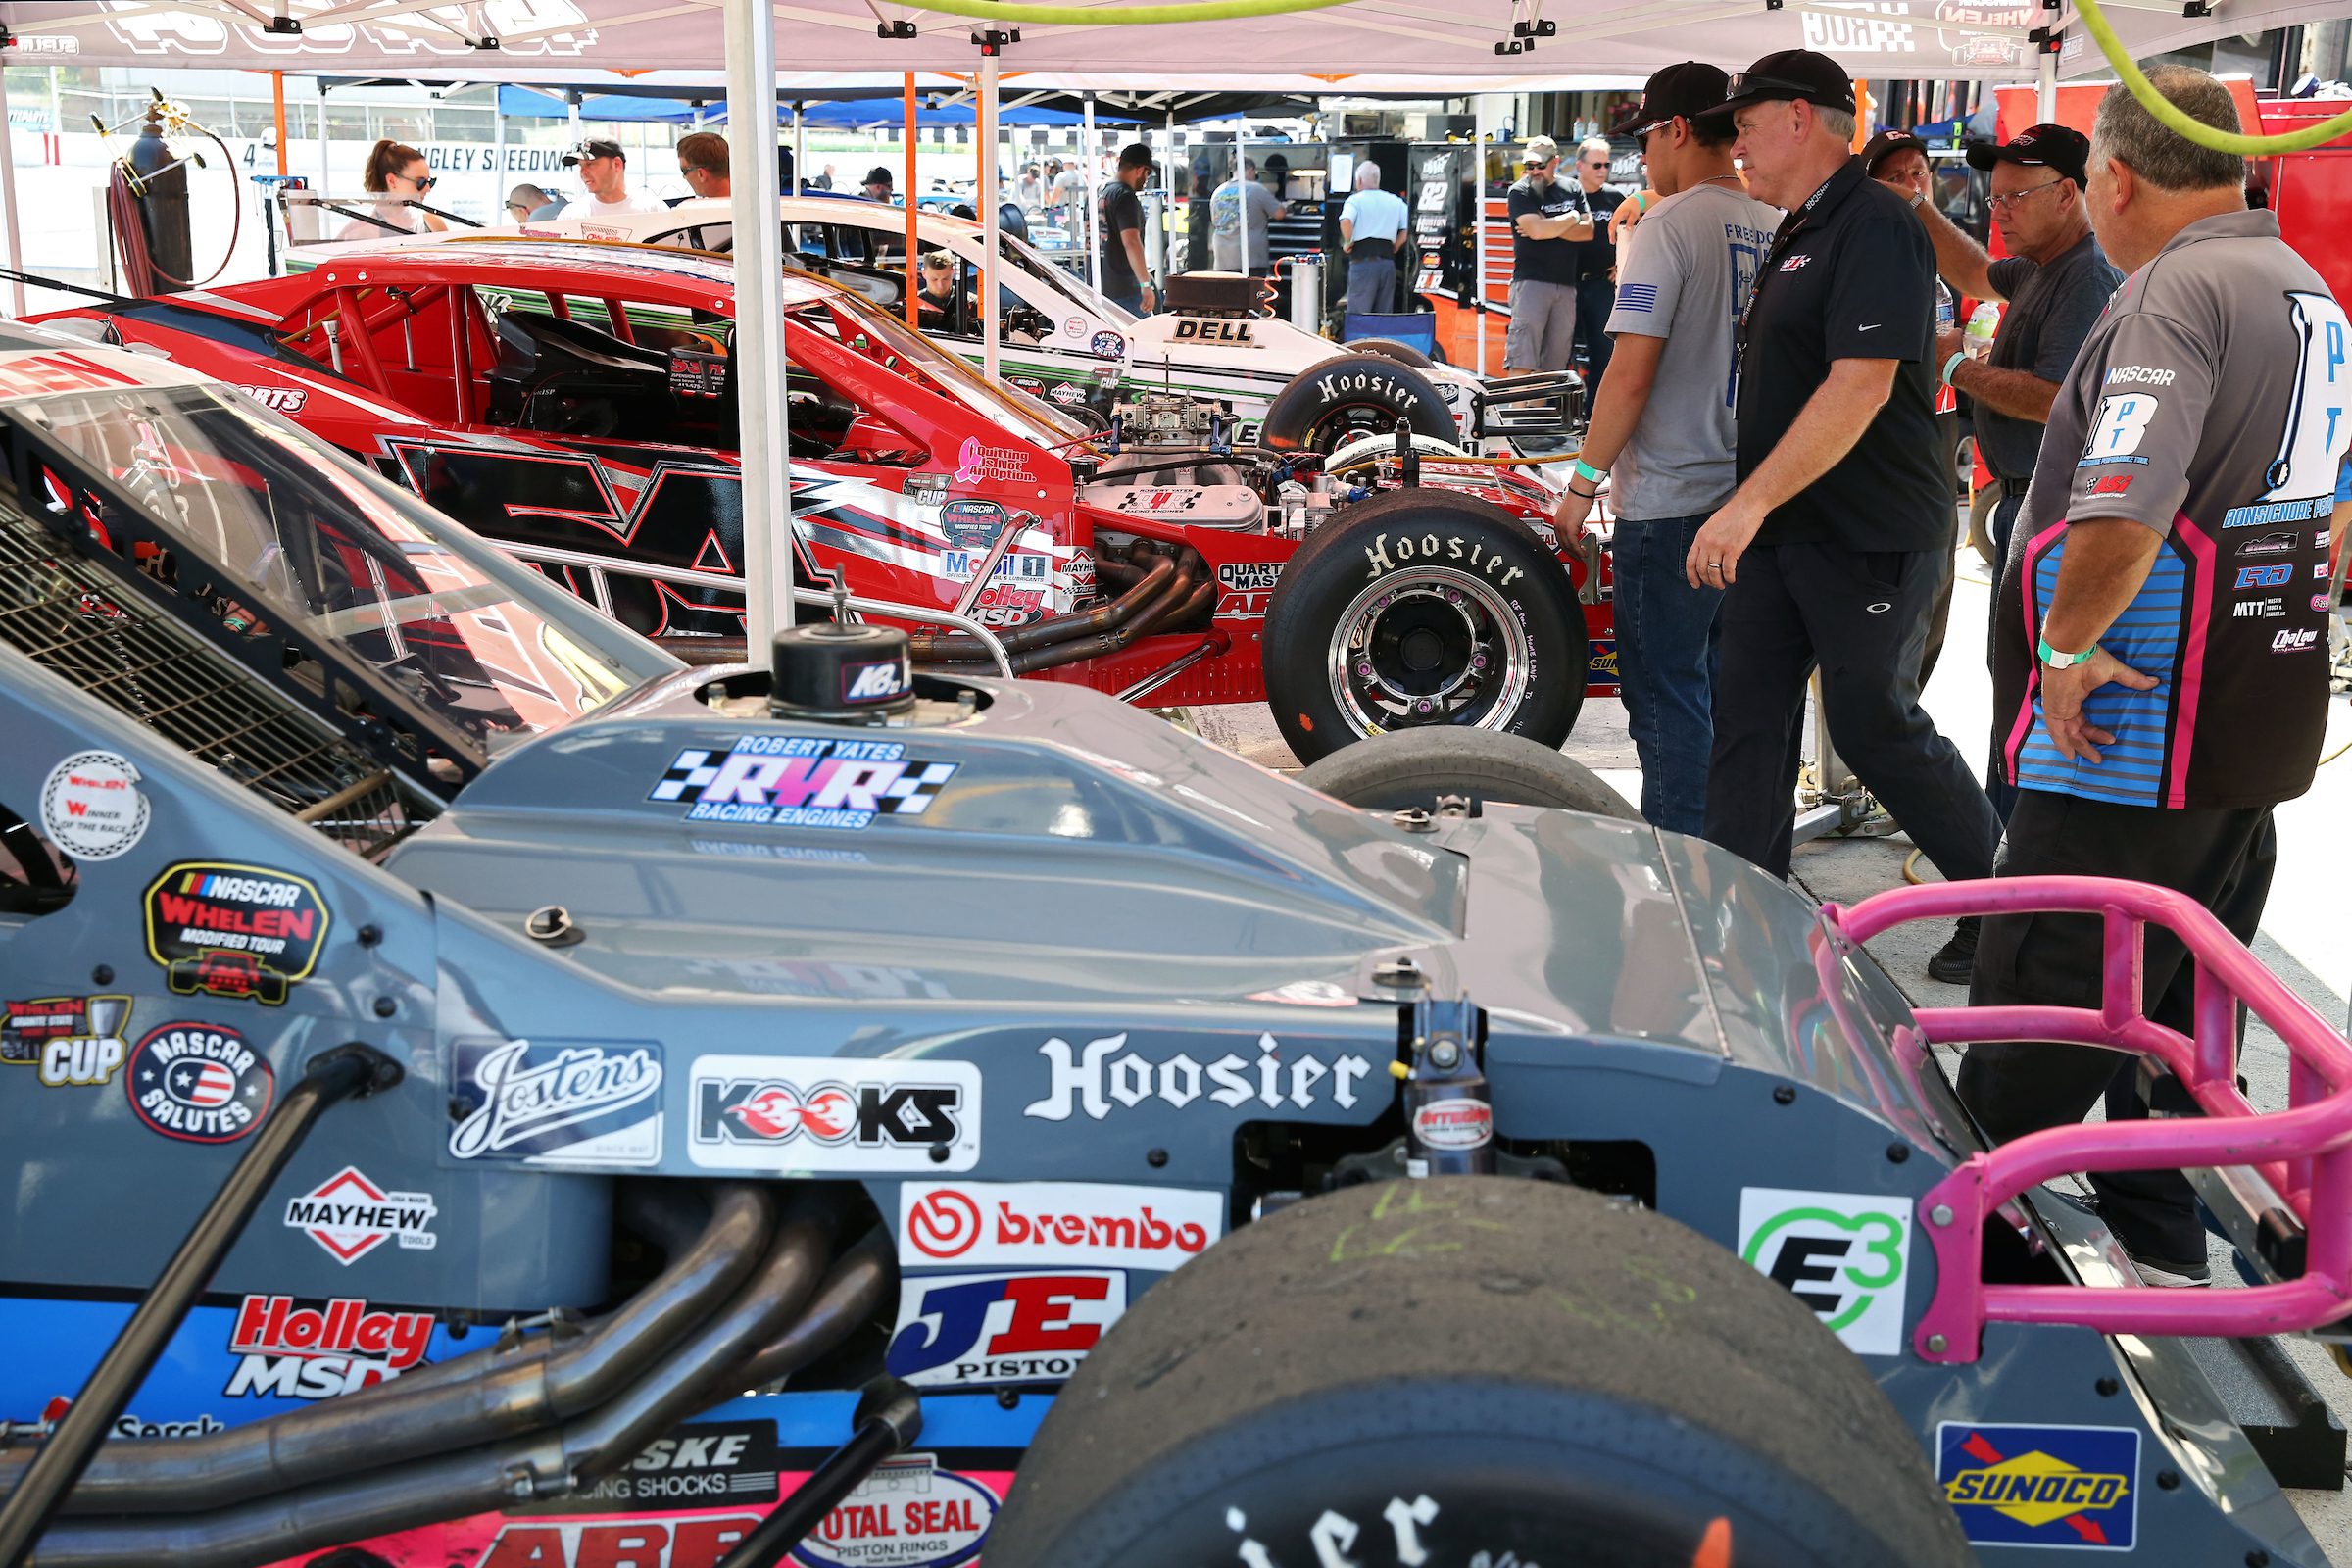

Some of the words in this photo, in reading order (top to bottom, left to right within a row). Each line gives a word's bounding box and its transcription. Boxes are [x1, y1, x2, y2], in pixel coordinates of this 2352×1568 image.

[418, 147, 477, 171] NGLEY
[482, 148, 573, 172] SPEEDW
[1724, 223, 1775, 245] FREEDO
[1175, 319, 1253, 342] DELL
[2107, 366, 2176, 386] NASCAR
[240, 386, 306, 413] ORTS
[1317, 372, 1419, 408] Hoosier
[977, 446, 1029, 463] Quitting
[981, 458, 997, 469] Is
[998, 459, 1022, 470] Not
[969, 465, 986, 476] An
[987, 467, 1037, 482] Option.
[917, 489, 947, 506] CUP
[962, 505, 995, 514] NASCAR
[946, 514, 1001, 524] WHELEN
[2222, 500, 2313, 529] BONSIGNORE
[1061, 564, 1095, 573] MAYHE
[1219, 564, 1287, 582] QUART
[1364, 533, 1524, 586] Hoosier
[964, 583, 1044, 614] olley
[2233, 601, 2264, 617] MTT
[967, 608, 1029, 627] MSD
[1591, 658, 1617, 670] SUN
[735, 736, 831, 757] ROBERT
[834, 740, 905, 760] YATES
[77, 822, 96, 831] THE
[689, 803, 780, 824] RACING
[780, 808, 874, 829] ENGINES
[209, 875, 300, 907] NASCAR
[158, 892, 316, 940] WHELEN
[179, 928, 245, 951] MODIFIED
[246, 934, 287, 955] TOUR
[44, 1038, 123, 1083] CUP
[150, 1031, 257, 1077] NASCAR
[1023, 1030, 1371, 1121] Hoosier
[141, 1087, 252, 1134] SALUTES
[450, 1039, 663, 1158] Jostens
[697, 1080, 961, 1146] KOOKS
[288, 1201, 427, 1230] MAYHEW
[997, 1201, 1207, 1254] brembo
[1767, 1210, 1903, 1313] E3
[231, 1295, 435, 1369] Holley
[886, 1276, 1111, 1376] JE
[956, 1358, 1081, 1379] PISTO
[622, 1435, 751, 1470] SKE
[638, 1473, 727, 1498] SHOCKS
[1952, 1474, 2121, 1505] SUNOCO
[824, 1504, 897, 1541] OTAL
[905, 1498, 980, 1536] SEAL
[837, 1544, 895, 1558] PISTON
[900, 1540, 949, 1553] RINGS
